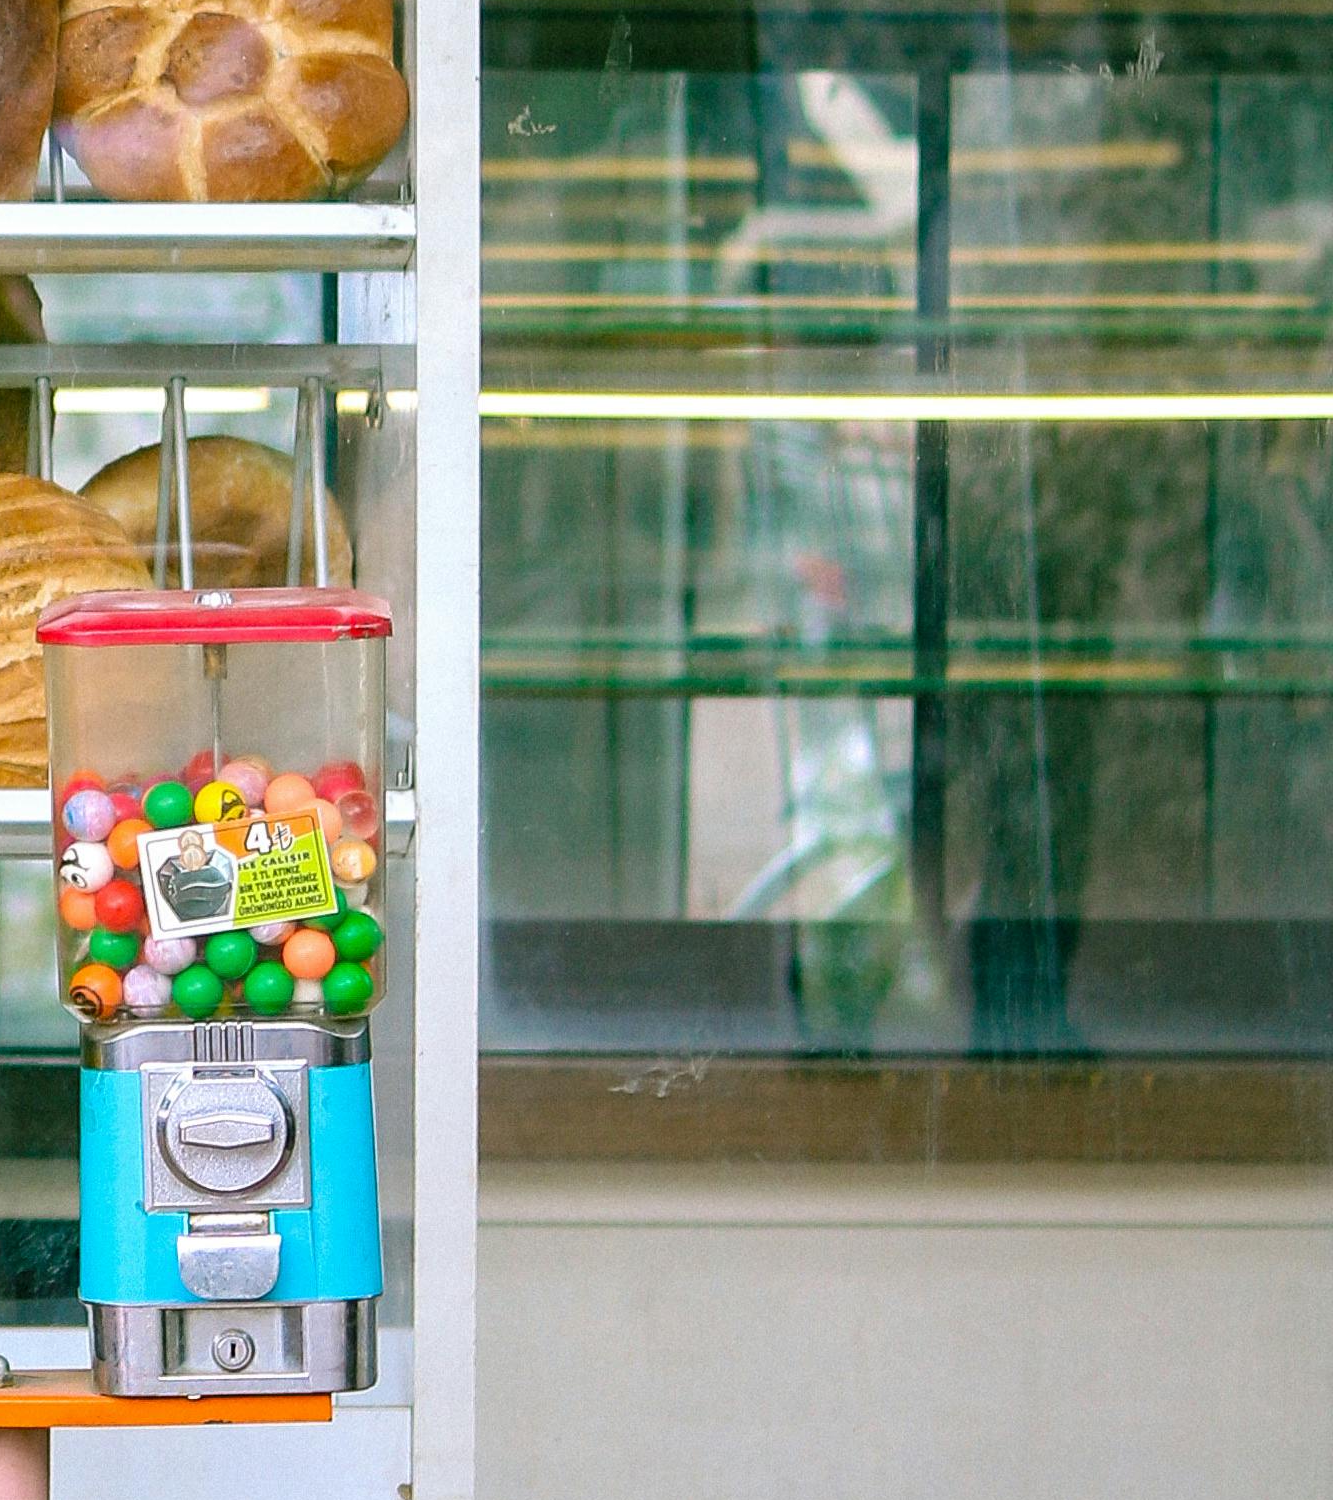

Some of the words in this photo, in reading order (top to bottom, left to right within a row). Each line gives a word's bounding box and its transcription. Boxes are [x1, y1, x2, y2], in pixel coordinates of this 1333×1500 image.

[259, 870, 271, 880] TL
[255, 880, 273, 891] TUR
[247, 893, 259, 903] TL
